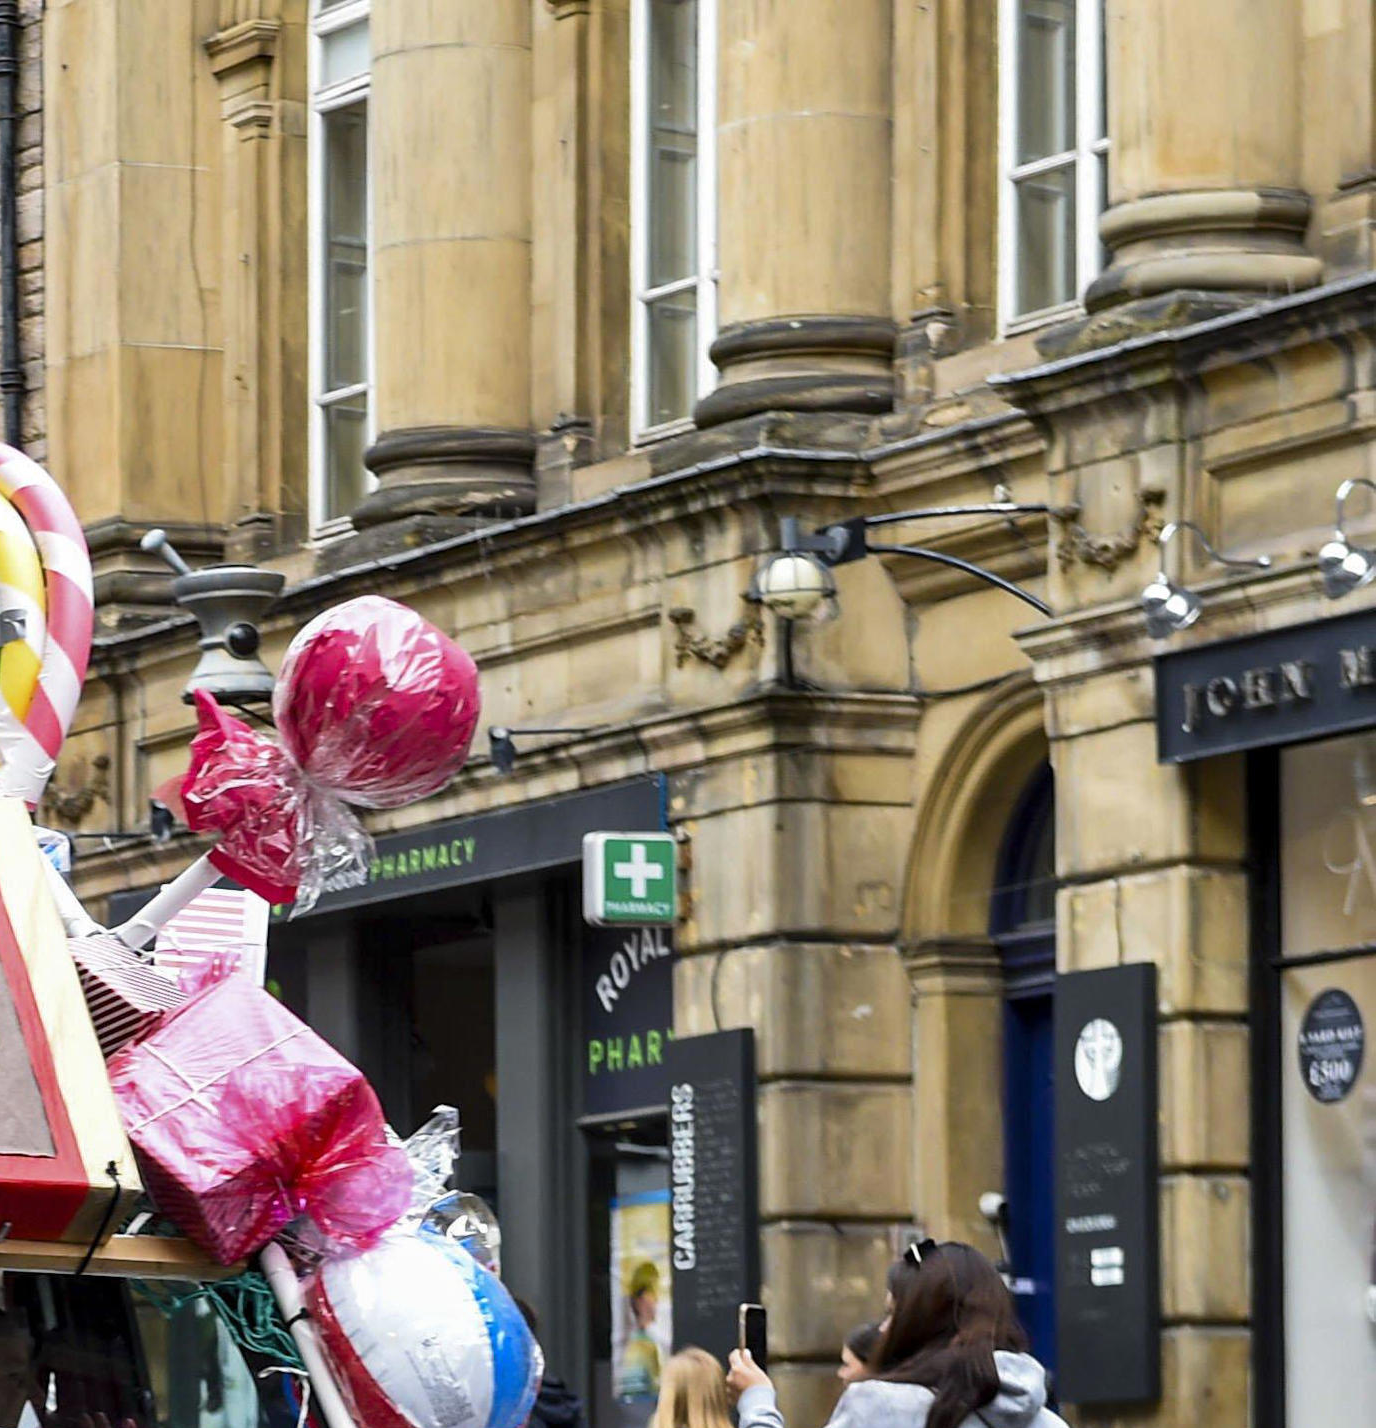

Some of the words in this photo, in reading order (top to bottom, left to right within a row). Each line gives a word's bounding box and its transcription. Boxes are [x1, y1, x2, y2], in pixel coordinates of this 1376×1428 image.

[1181, 660, 1313, 734] JOHN
[369, 836, 476, 881] PHARMACY
[606, 901, 672, 916] PHARMACY
[596, 927, 671, 1014] ROYAL
[588, 1028, 677, 1075] PHAR
[671, 1083, 696, 1271] CARRUBBERS
